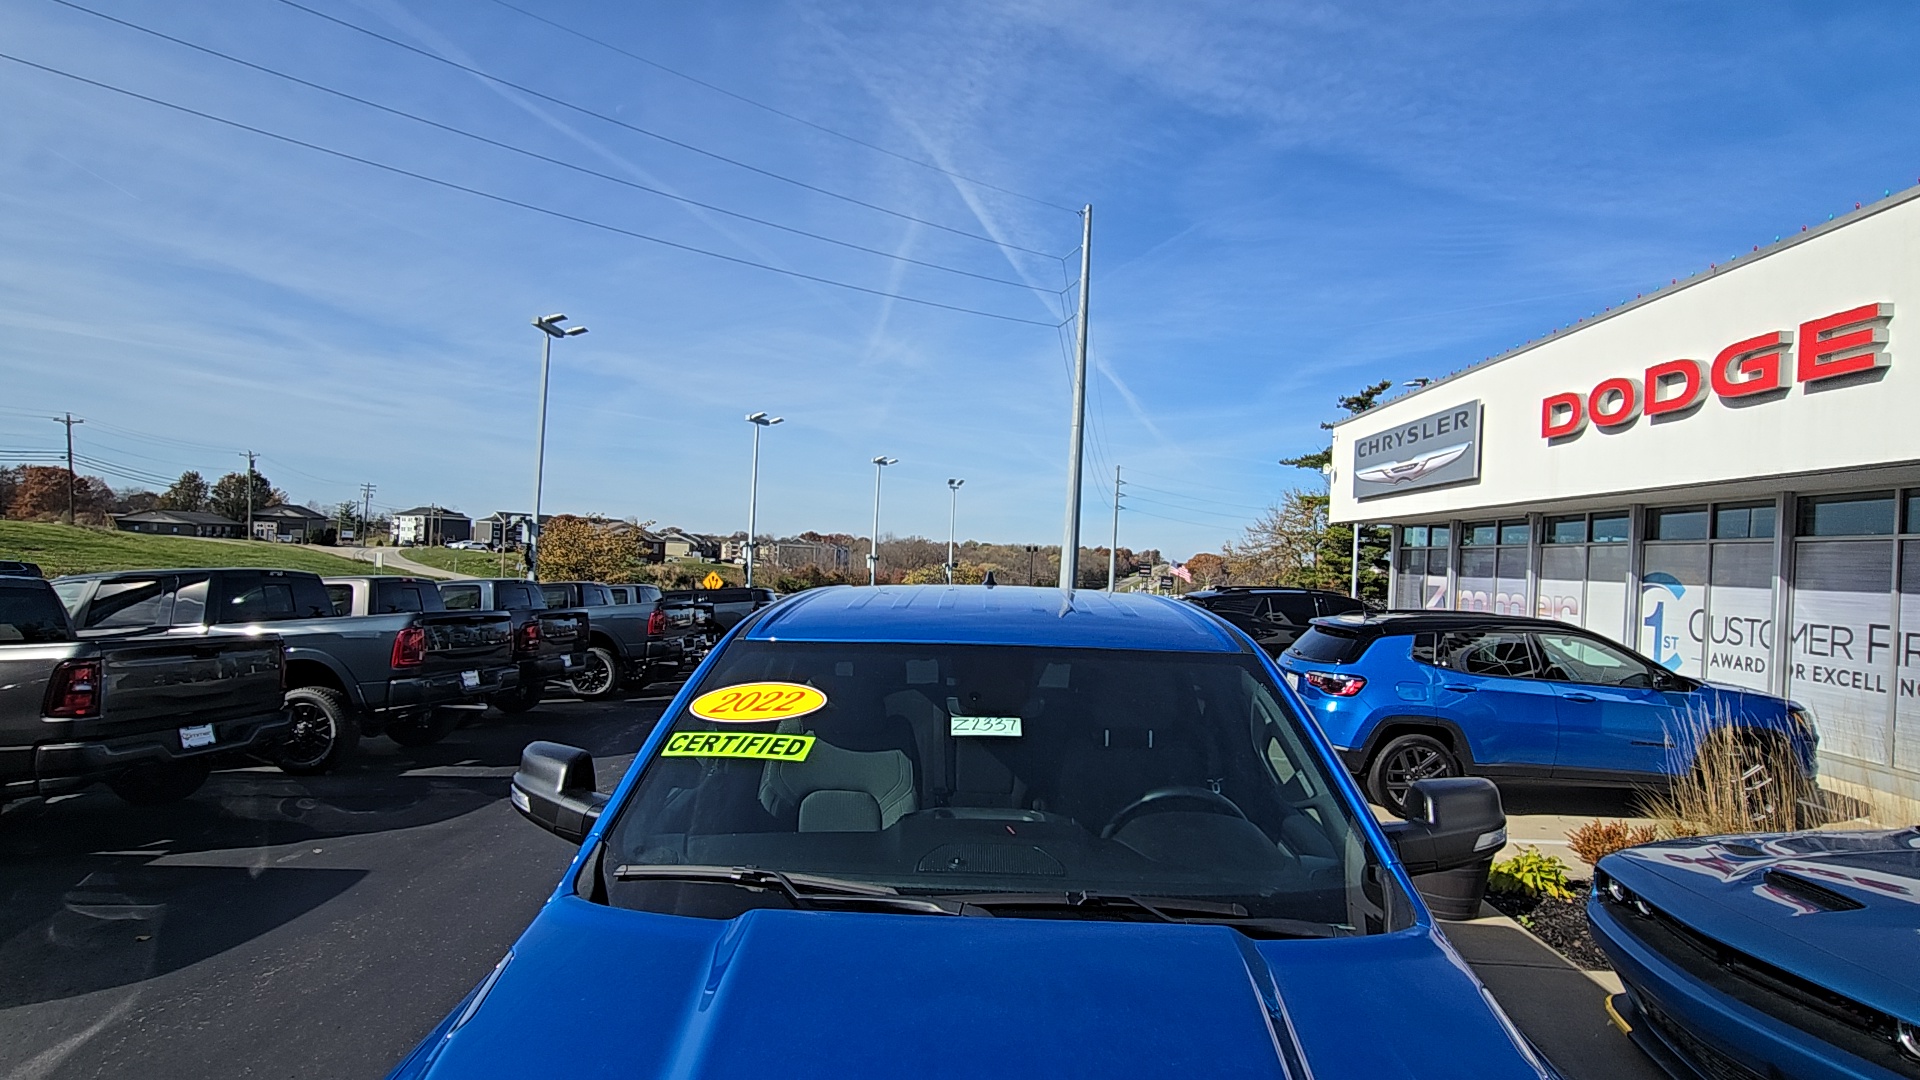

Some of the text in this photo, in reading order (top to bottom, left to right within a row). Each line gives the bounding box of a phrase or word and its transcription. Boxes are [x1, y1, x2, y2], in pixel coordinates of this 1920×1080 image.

[1541, 303, 1894, 440] DODGE
[1357, 410, 1469, 458] CHRYSLER
[1710, 652, 1766, 673] AWARD
[1812, 665, 1920, 698] EXCELLN
[708, 691, 806, 713] 2022
[667, 734, 806, 756] CERTIFIED
